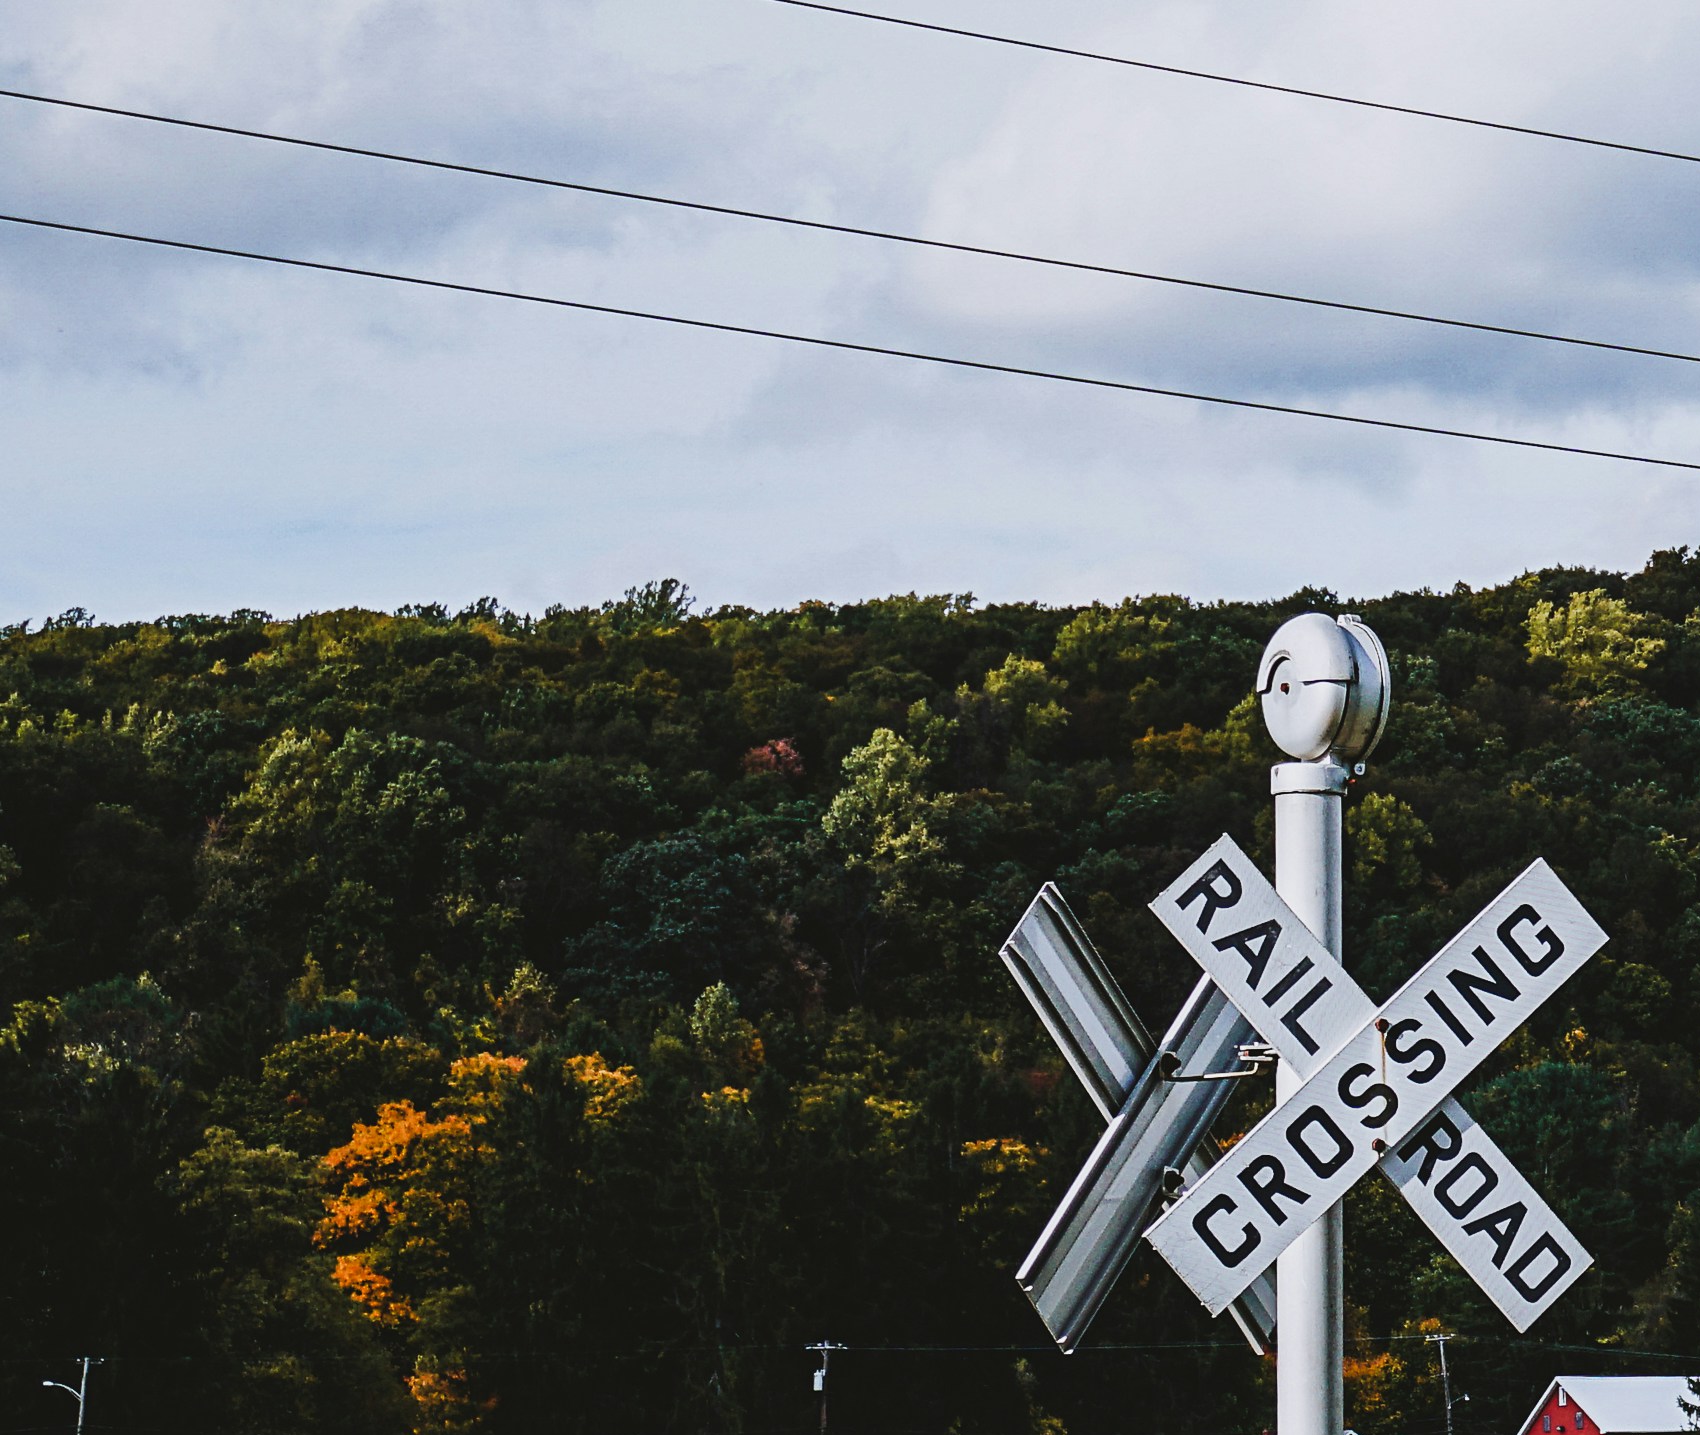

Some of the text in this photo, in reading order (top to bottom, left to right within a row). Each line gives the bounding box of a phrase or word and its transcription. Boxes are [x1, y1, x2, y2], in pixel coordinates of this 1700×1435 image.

[1175, 858, 1571, 1303] RAIL ROAD
[1192, 903, 1565, 1268] CROSSING
